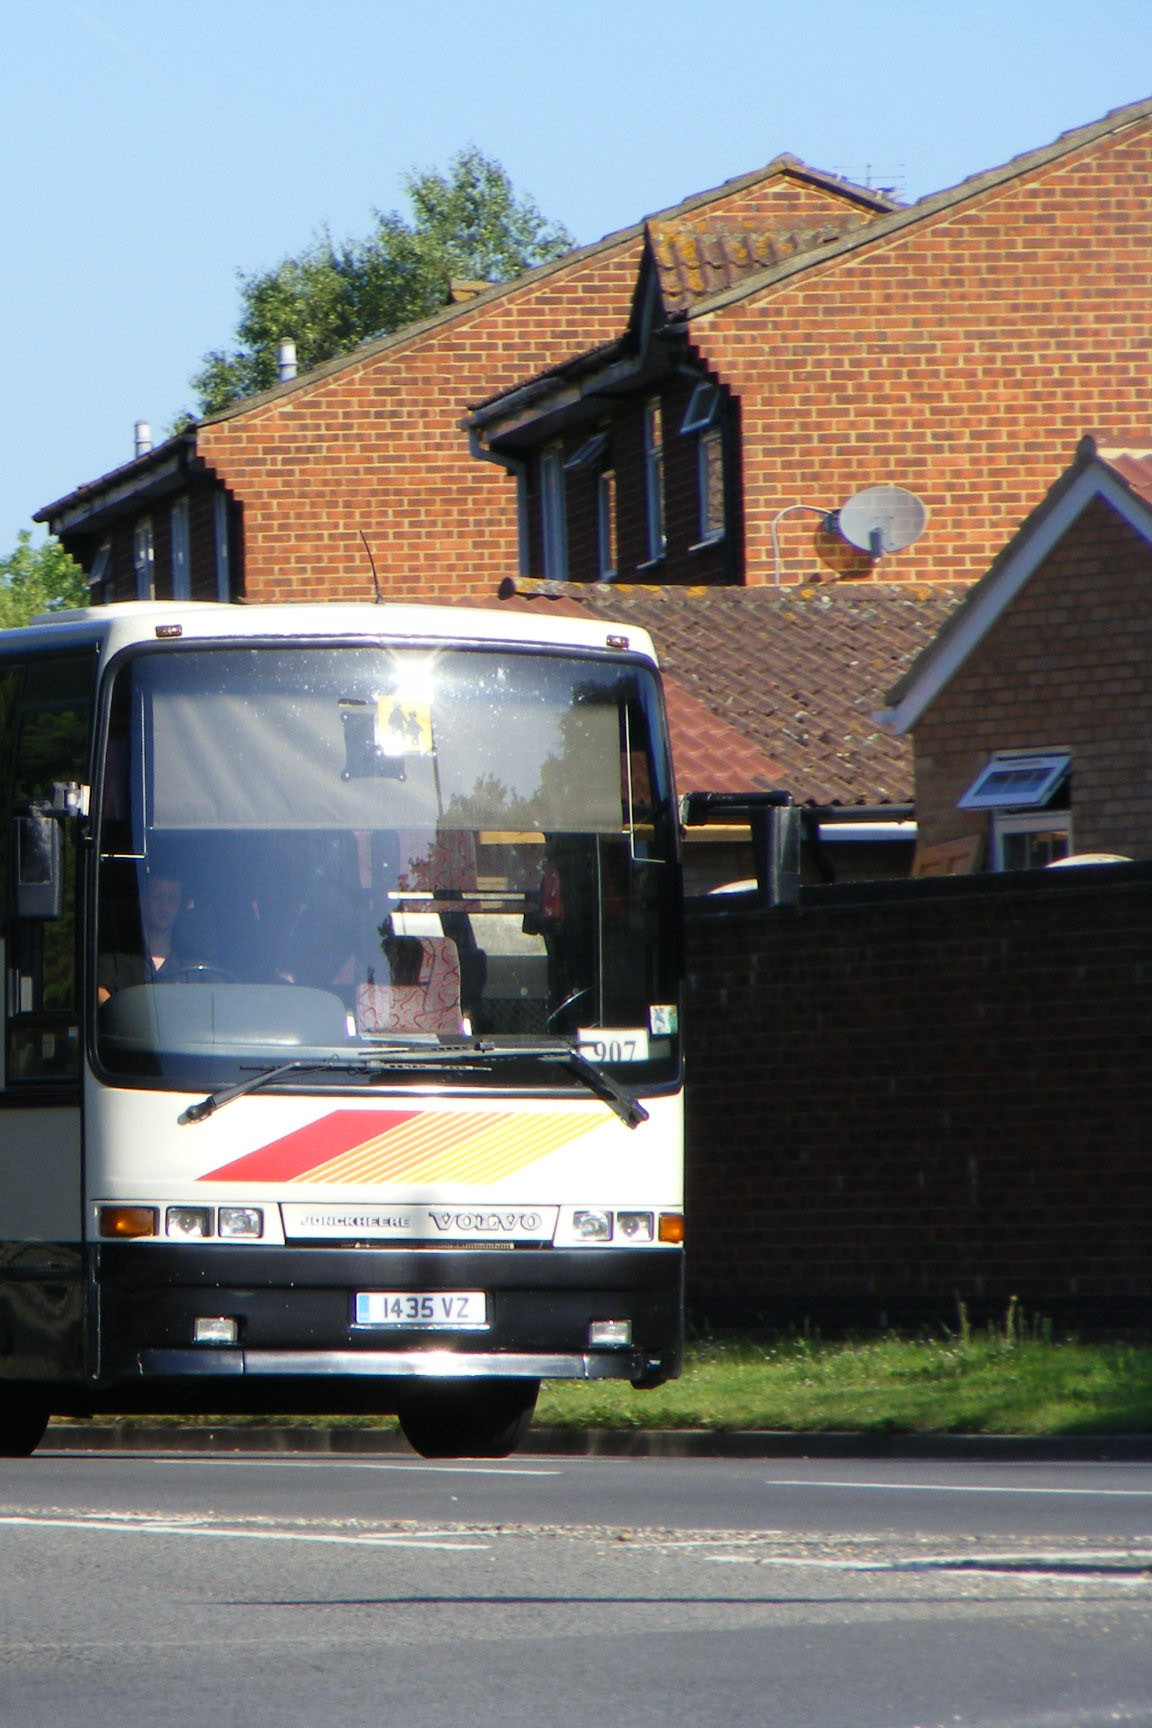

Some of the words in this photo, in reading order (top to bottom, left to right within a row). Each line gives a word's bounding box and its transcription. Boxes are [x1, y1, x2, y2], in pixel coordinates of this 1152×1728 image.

[593, 1040, 637, 1062] 907
[428, 1211, 542, 1231] VOLVO
[384, 1297, 434, 1318] 1435
[441, 1297, 470, 1318] VZ
